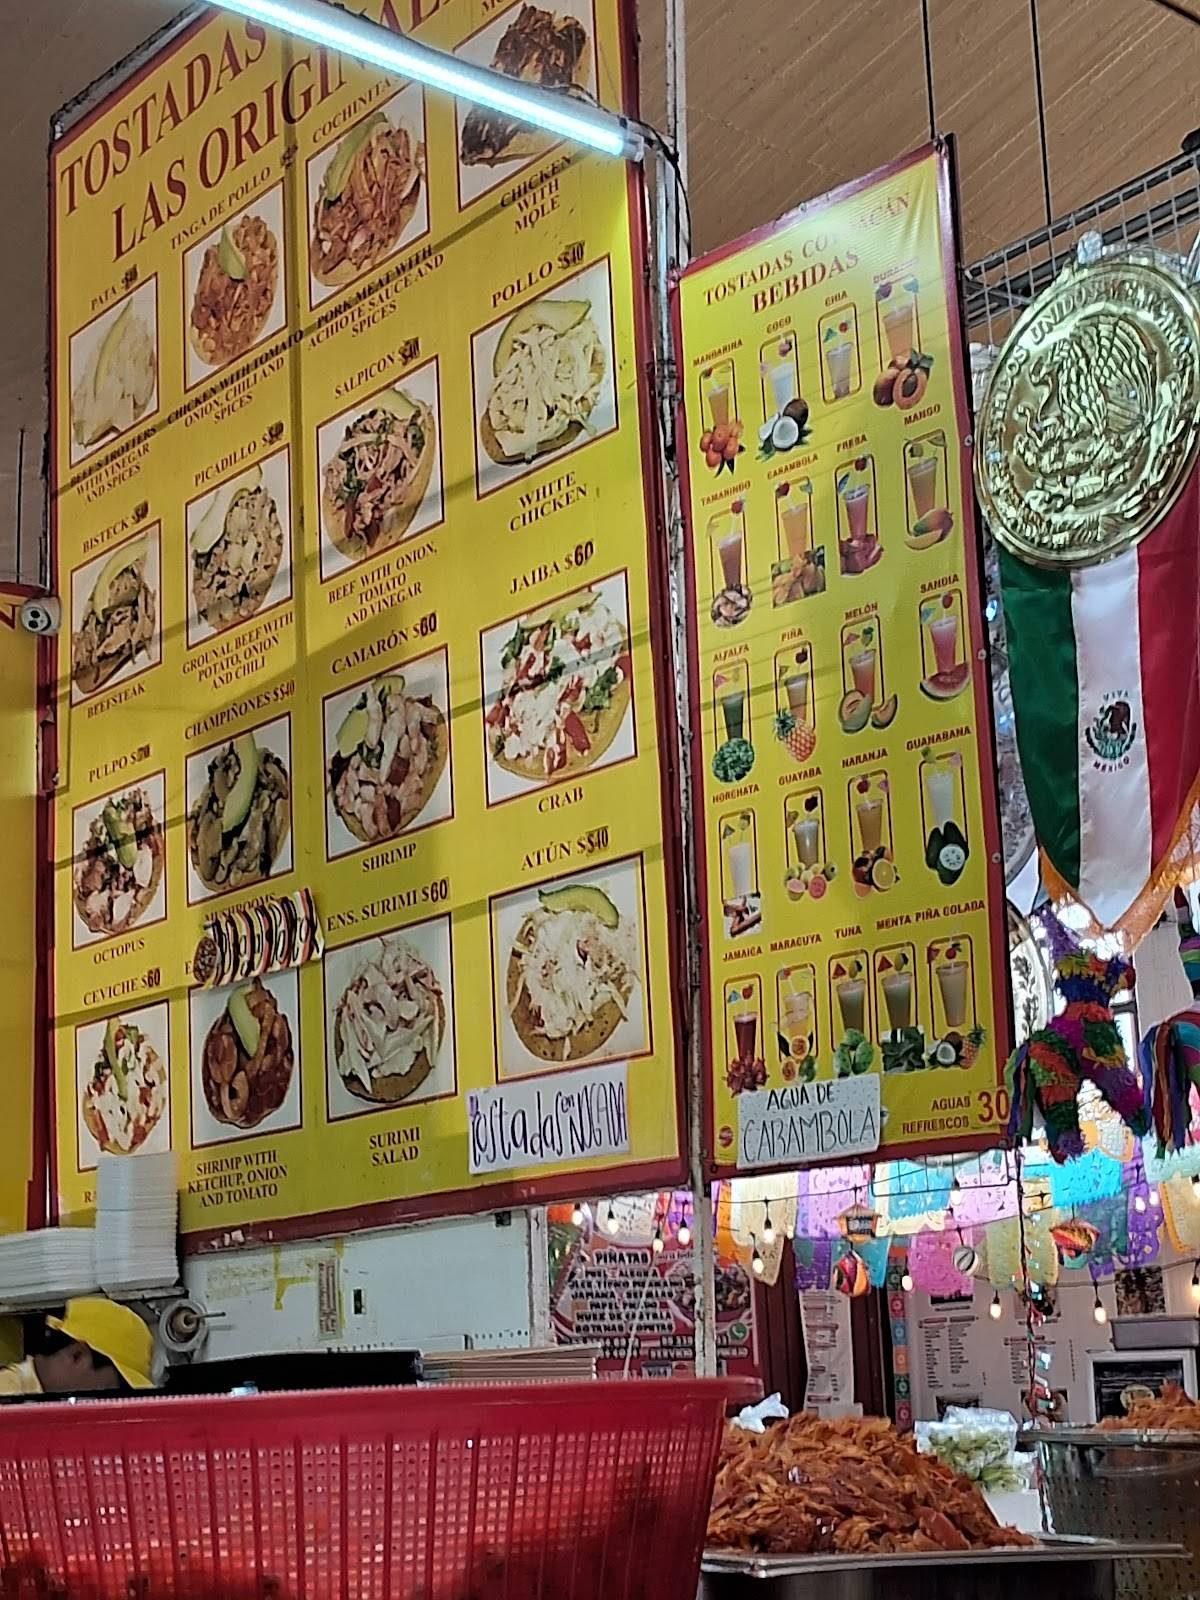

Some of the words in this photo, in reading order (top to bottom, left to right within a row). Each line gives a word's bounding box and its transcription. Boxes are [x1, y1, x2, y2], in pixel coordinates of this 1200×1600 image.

[60, 16, 267, 216] TOSTADAS
[312, 78, 391, 144] COCHINITA
[500, 155, 574, 208] CHICKEN
[517, 178, 559, 212] WITH
[112, 156, 187, 262] LAS
[170, 217, 206, 249] TINGA
[209, 200, 225, 221] DE
[228, 167, 271, 206] POLLO
[515, 195, 560, 234] MOLE
[316, 300, 353, 329] PORK
[356, 271, 391, 301] MEAT
[394, 244, 433, 276] WITH
[492, 261, 553, 308] POLLO
[703, 250, 794, 307] TOSTADAS
[752, 249, 860, 314] BEBIDAS
[309, 304, 366, 348] ACHIOTE
[369, 274, 411, 310] SAUCE
[414, 254, 444, 282] AND
[824, 290, 848, 308] CHIA
[352, 300, 397, 338] SPICES
[766, 315, 792, 335] COCO
[260, 357, 284, 382] AND
[692, 338, 744, 368] MANDARINA
[168, 385, 218, 424] CHICKEN
[219, 363, 250, 390] WITH
[253, 330, 304, 369] TOMATO
[214, 392, 253, 424] SPICES
[903, 403, 941, 426] MANGO
[836, 433, 868, 453] FRESA
[77, 472, 102, 495] WITH
[104, 443, 150, 478] VINEGAR
[107, 464, 141, 492] SPICES
[194, 440, 257, 487] PICADILLO
[767, 453, 819, 480] CARAMBOLA
[518, 471, 577, 509] WHITE
[701, 480, 752, 507] TAMARINDO
[509, 486, 588, 533] CHICKEN
[82, 516, 129, 553] BISTECK
[328, 580, 357, 605] BEEF
[359, 564, 391, 588] WITH
[510, 560, 561, 595] JAIBA
[564, 540, 595, 571] $60
[344, 605, 368, 629] AND
[370, 582, 423, 619] VINEGAR
[358, 572, 407, 605] TOMATO
[235, 626, 262, 650] BEEF
[263, 611, 294, 634] WITH
[243, 635, 280, 660] ONION
[781, 627, 804, 643] PIÑA
[331, 622, 410, 676] CAMARÓN
[713, 643, 750, 664] ALFALFA
[212, 671, 233, 690] AND
[235, 655, 266, 680] CHILI
[87, 681, 146, 719] BEEFSTEAK
[185, 690, 271, 740] CHAMPIÑONES
[906, 725, 972, 752] GUANABANA
[89, 755, 127, 783] PULPO
[841, 748, 889, 769] NARANJA
[712, 783, 760, 804] HORCHATA
[778, 766, 822, 787] GUAYABA
[537, 787, 584, 814] CRAB
[361, 843, 418, 873] SHRIMP
[520, 841, 572, 872] ATÚN
[326, 908, 359, 933] ENS.
[361, 888, 418, 922] SURIMI
[421, 878, 449, 905] $60
[722, 945, 763, 963] JAMAICA
[769, 931, 822, 953] MARACUYA
[834, 925, 863, 939] TUNA
[876, 915, 912, 932] MENTA
[915, 907, 941, 923] PIÑA
[943, 900, 986, 918] COLADA
[92, 937, 146, 966] OCTOPUS
[83, 979, 140, 1007] CEVICHE
[141, 967, 161, 991] $60
[766, 1088, 810, 1112] AGUA
[816, 1082, 837, 1104] DE
[931, 1096, 971, 1112] AGUAS
[977, 1089, 1010, 1124] 30
[369, 1126, 421, 1151] SURIMI
[743, 1105, 877, 1163] CARAMBOLA
[902, 1116, 970, 1136] REFRESCOS
[196, 1154, 242, 1176] SHRIMP
[244, 1149, 278, 1167] WITH
[371, 1145, 420, 1167] SALAD
[248, 1165, 288, 1185] ONION
[200, 1190, 224, 1209] AND
[226, 1183, 279, 1205] TOMATO
